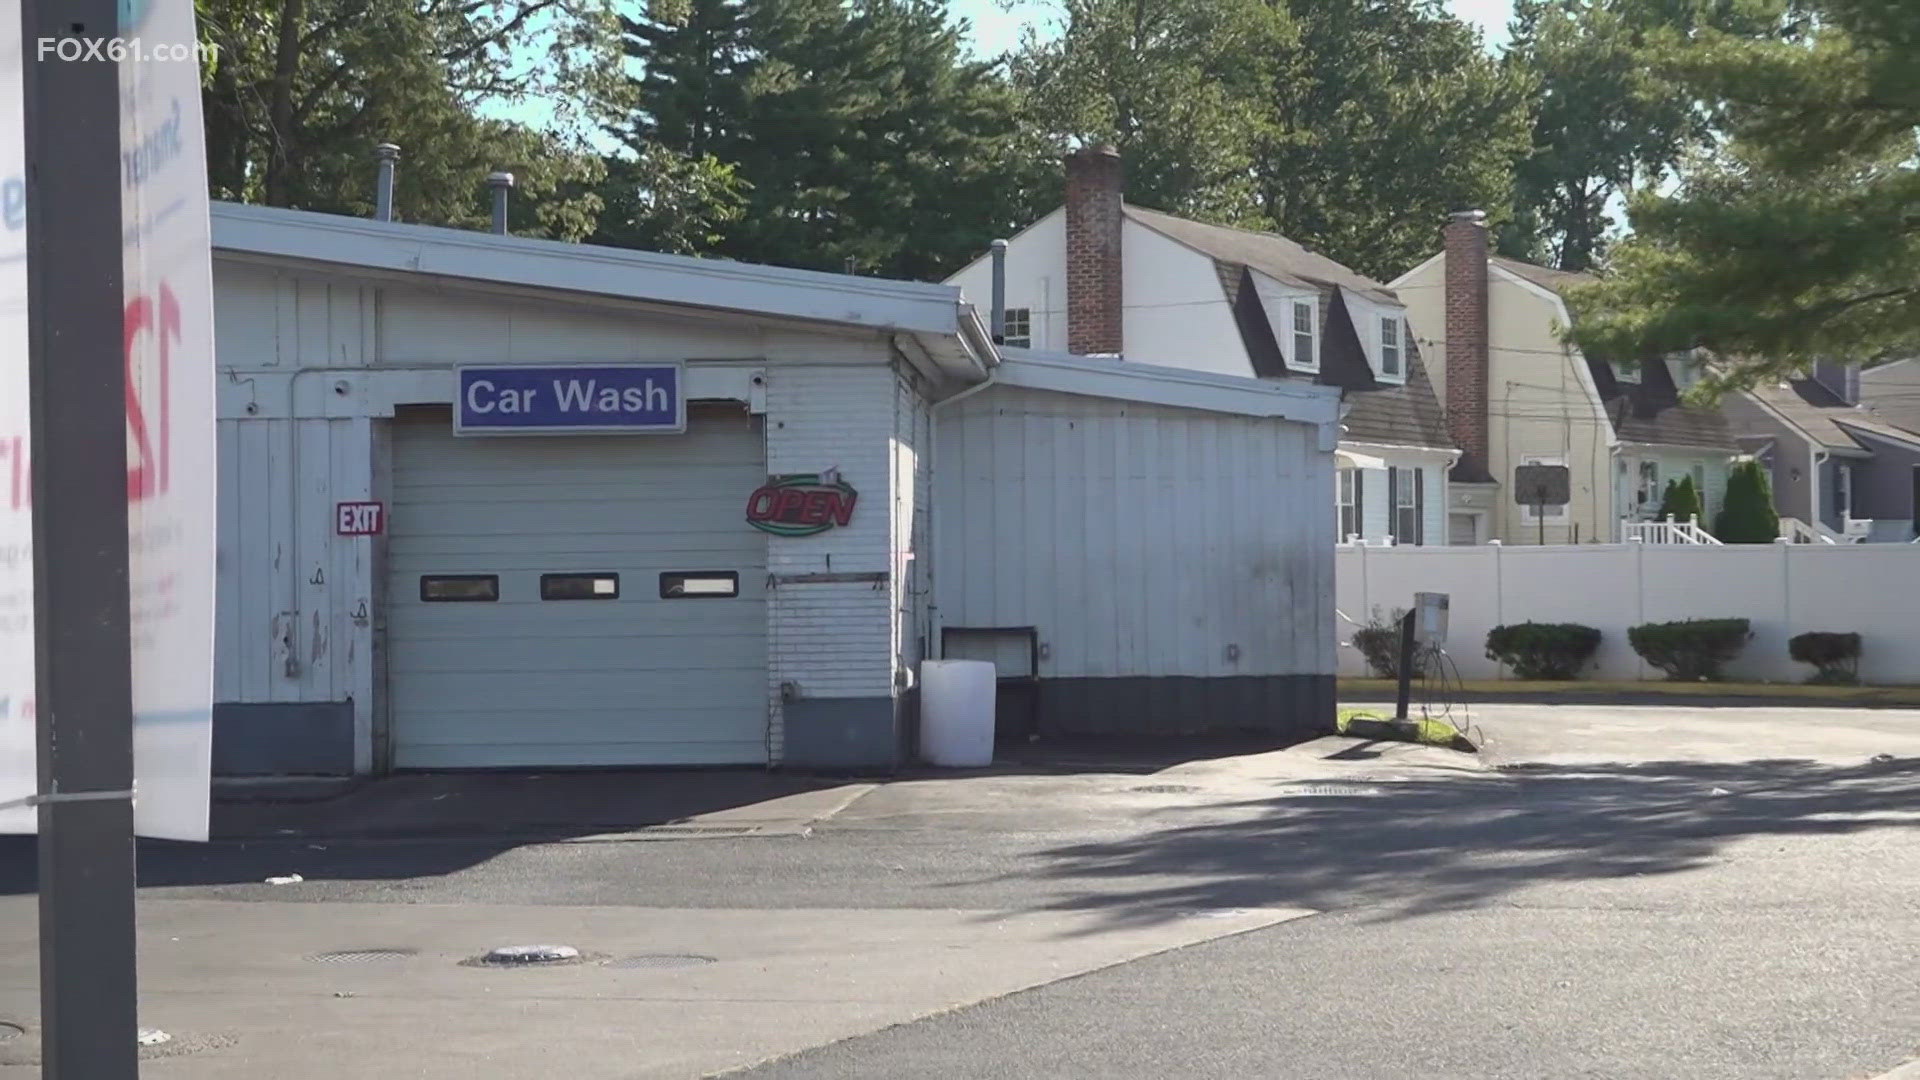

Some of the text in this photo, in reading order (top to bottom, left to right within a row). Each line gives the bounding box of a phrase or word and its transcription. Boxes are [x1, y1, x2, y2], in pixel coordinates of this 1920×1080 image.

[467, 379, 668, 414] Car Wash
[340, 505, 380, 532] EXIT
[746, 485, 857, 527] OPEN
